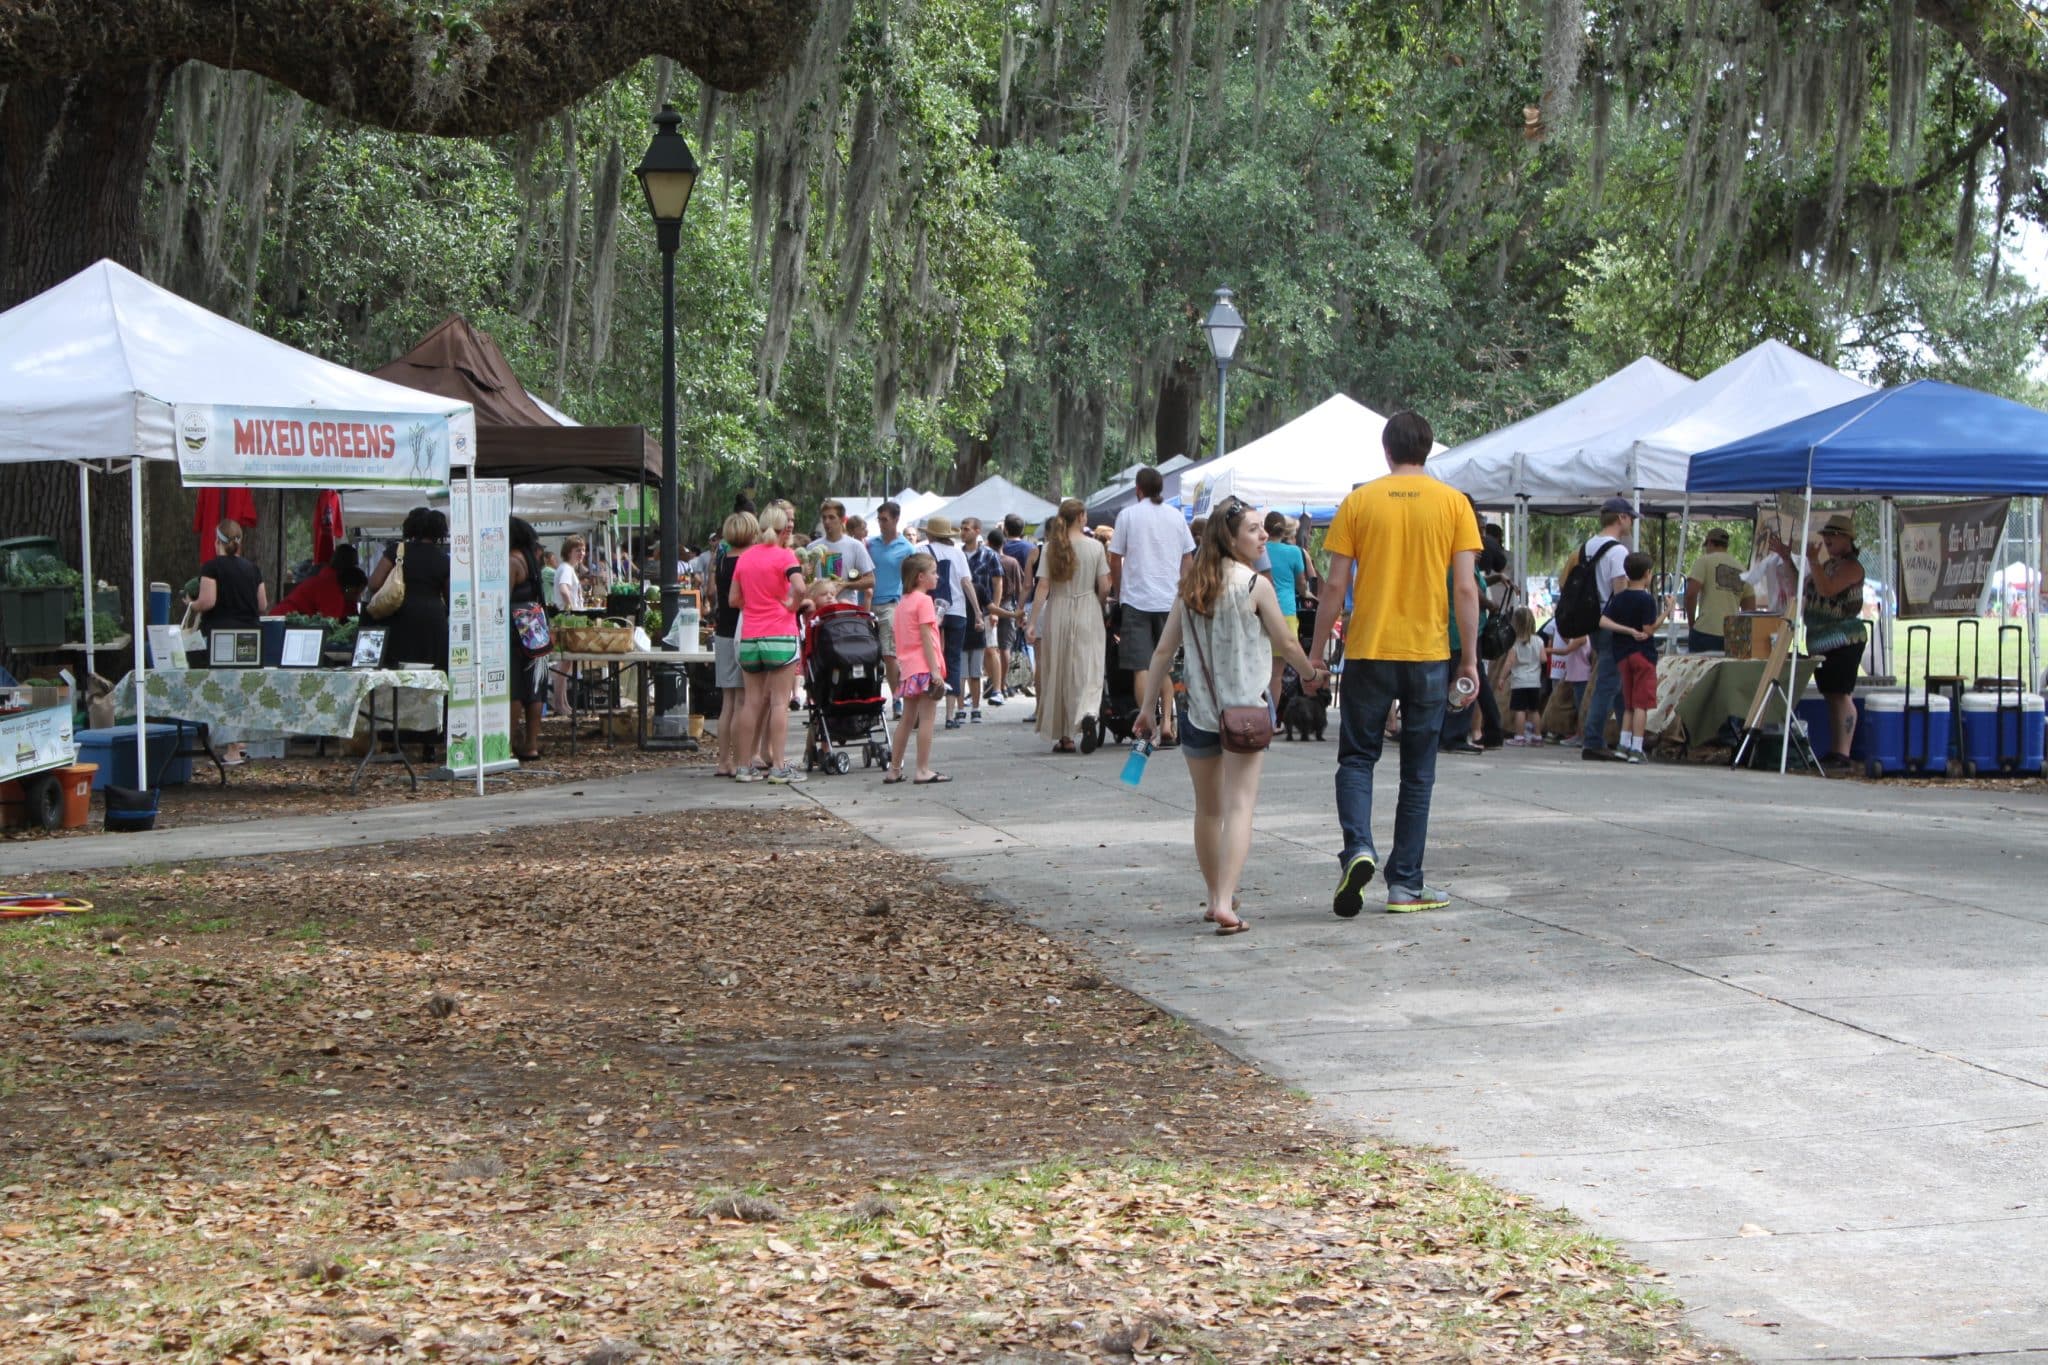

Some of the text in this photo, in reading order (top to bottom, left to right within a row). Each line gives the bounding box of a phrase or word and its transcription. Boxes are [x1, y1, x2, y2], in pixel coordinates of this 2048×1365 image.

[233, 418, 396, 459] MIXED GREENS
[1905, 556, 1938, 577] VANNAH
